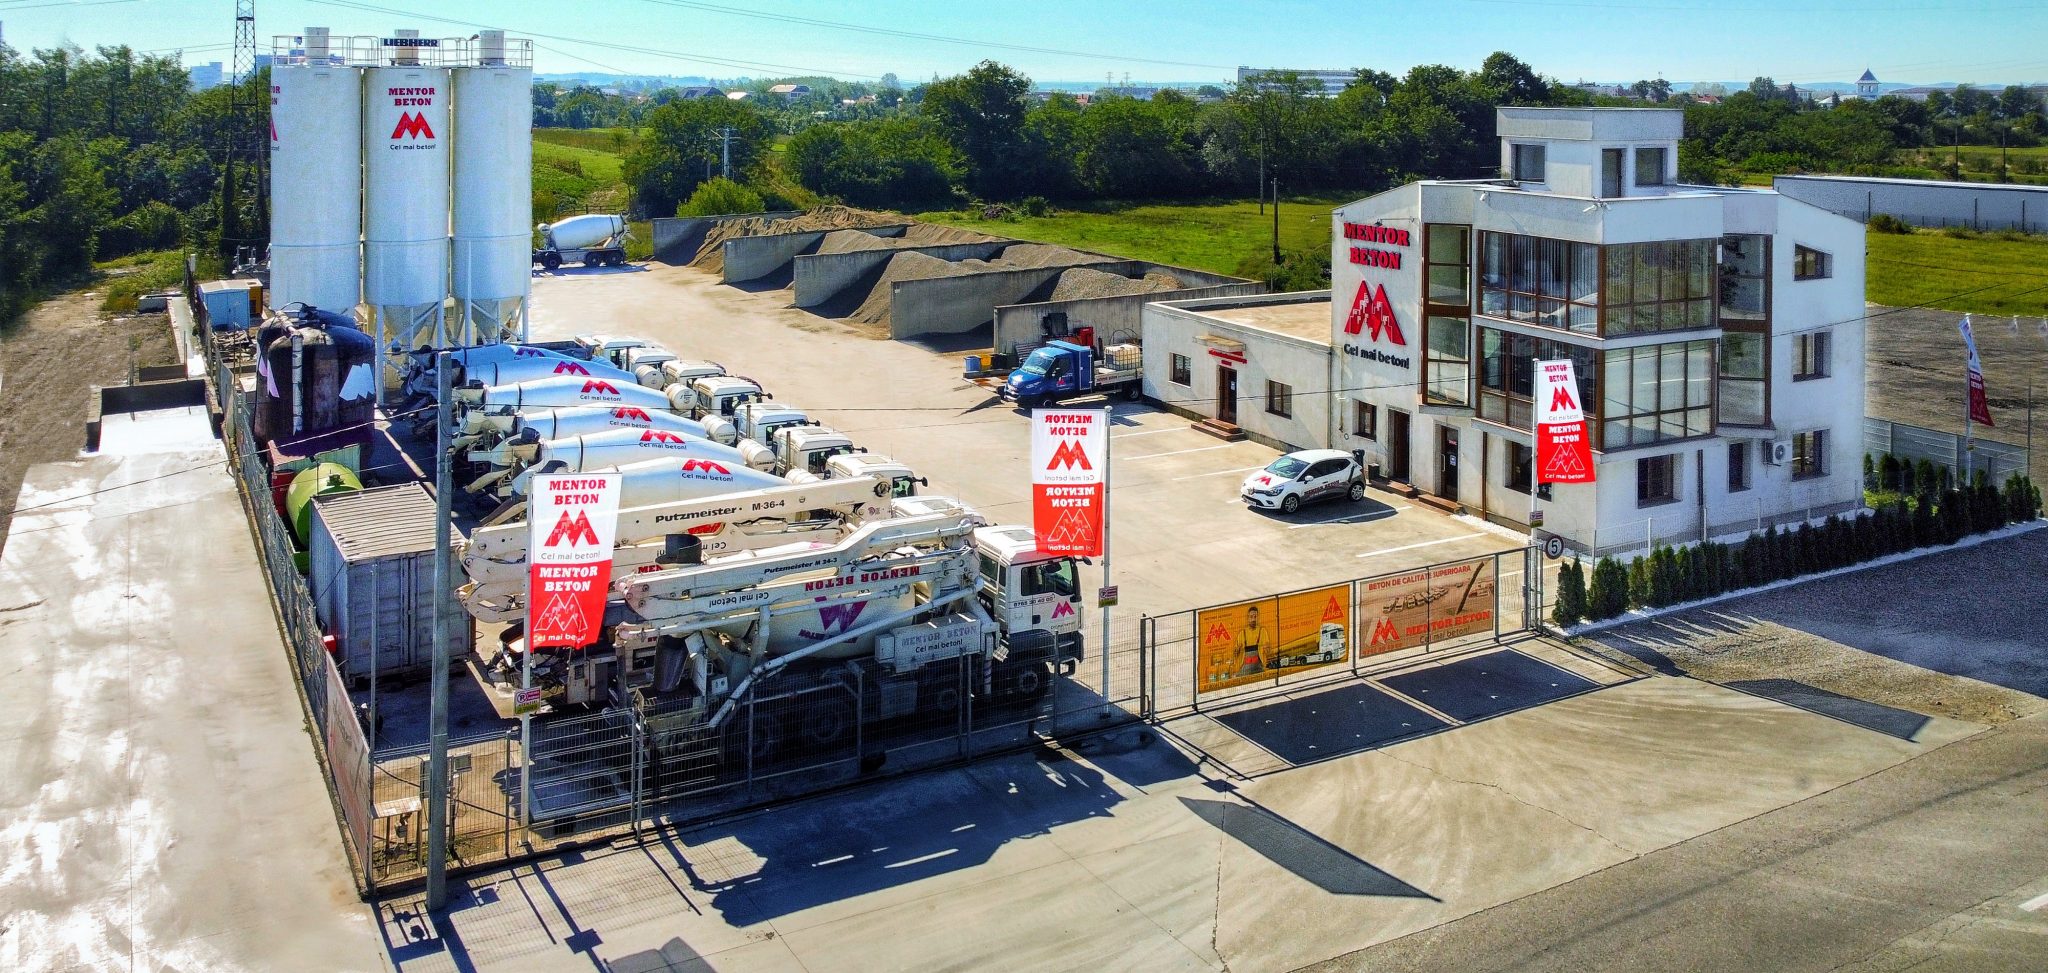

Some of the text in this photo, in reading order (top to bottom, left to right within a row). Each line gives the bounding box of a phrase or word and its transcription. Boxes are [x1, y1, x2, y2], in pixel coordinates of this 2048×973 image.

[383, 38, 438, 47] LIEBHERR
[388, 87, 436, 96] MENTOR
[394, 98, 432, 107] BETON
[1343, 222, 1410, 247] MENTOR
[1349, 247, 1401, 270] BETON
[1343, 342, 1409, 370] Cel mai beton!
[1548, 374, 1568, 383] BETON
[1548, 423, 1581, 434] MENTOR
[1552, 433, 1580, 444] BETON
[549, 479, 607, 491] MENTOR
[554, 493, 600, 506] BETON
[655, 506, 737, 524] Putzmeister
[1551, 539, 1558, 555] 5
[541, 551, 556, 560] Cel
[574, 550, 601, 561] beton!
[539, 566, 599, 579] MENTOR
[764, 562, 814, 575] Putzmeister
[804, 565, 920, 592] MENTOR BETON
[544, 580, 592, 592] BETON
[1368, 579, 1391, 591] BETON
[1391, 579, 1401, 587] DE
[755, 591, 769, 600] Cel
[708, 596, 737, 608] beton!
[915, 645, 928, 653] Cel
